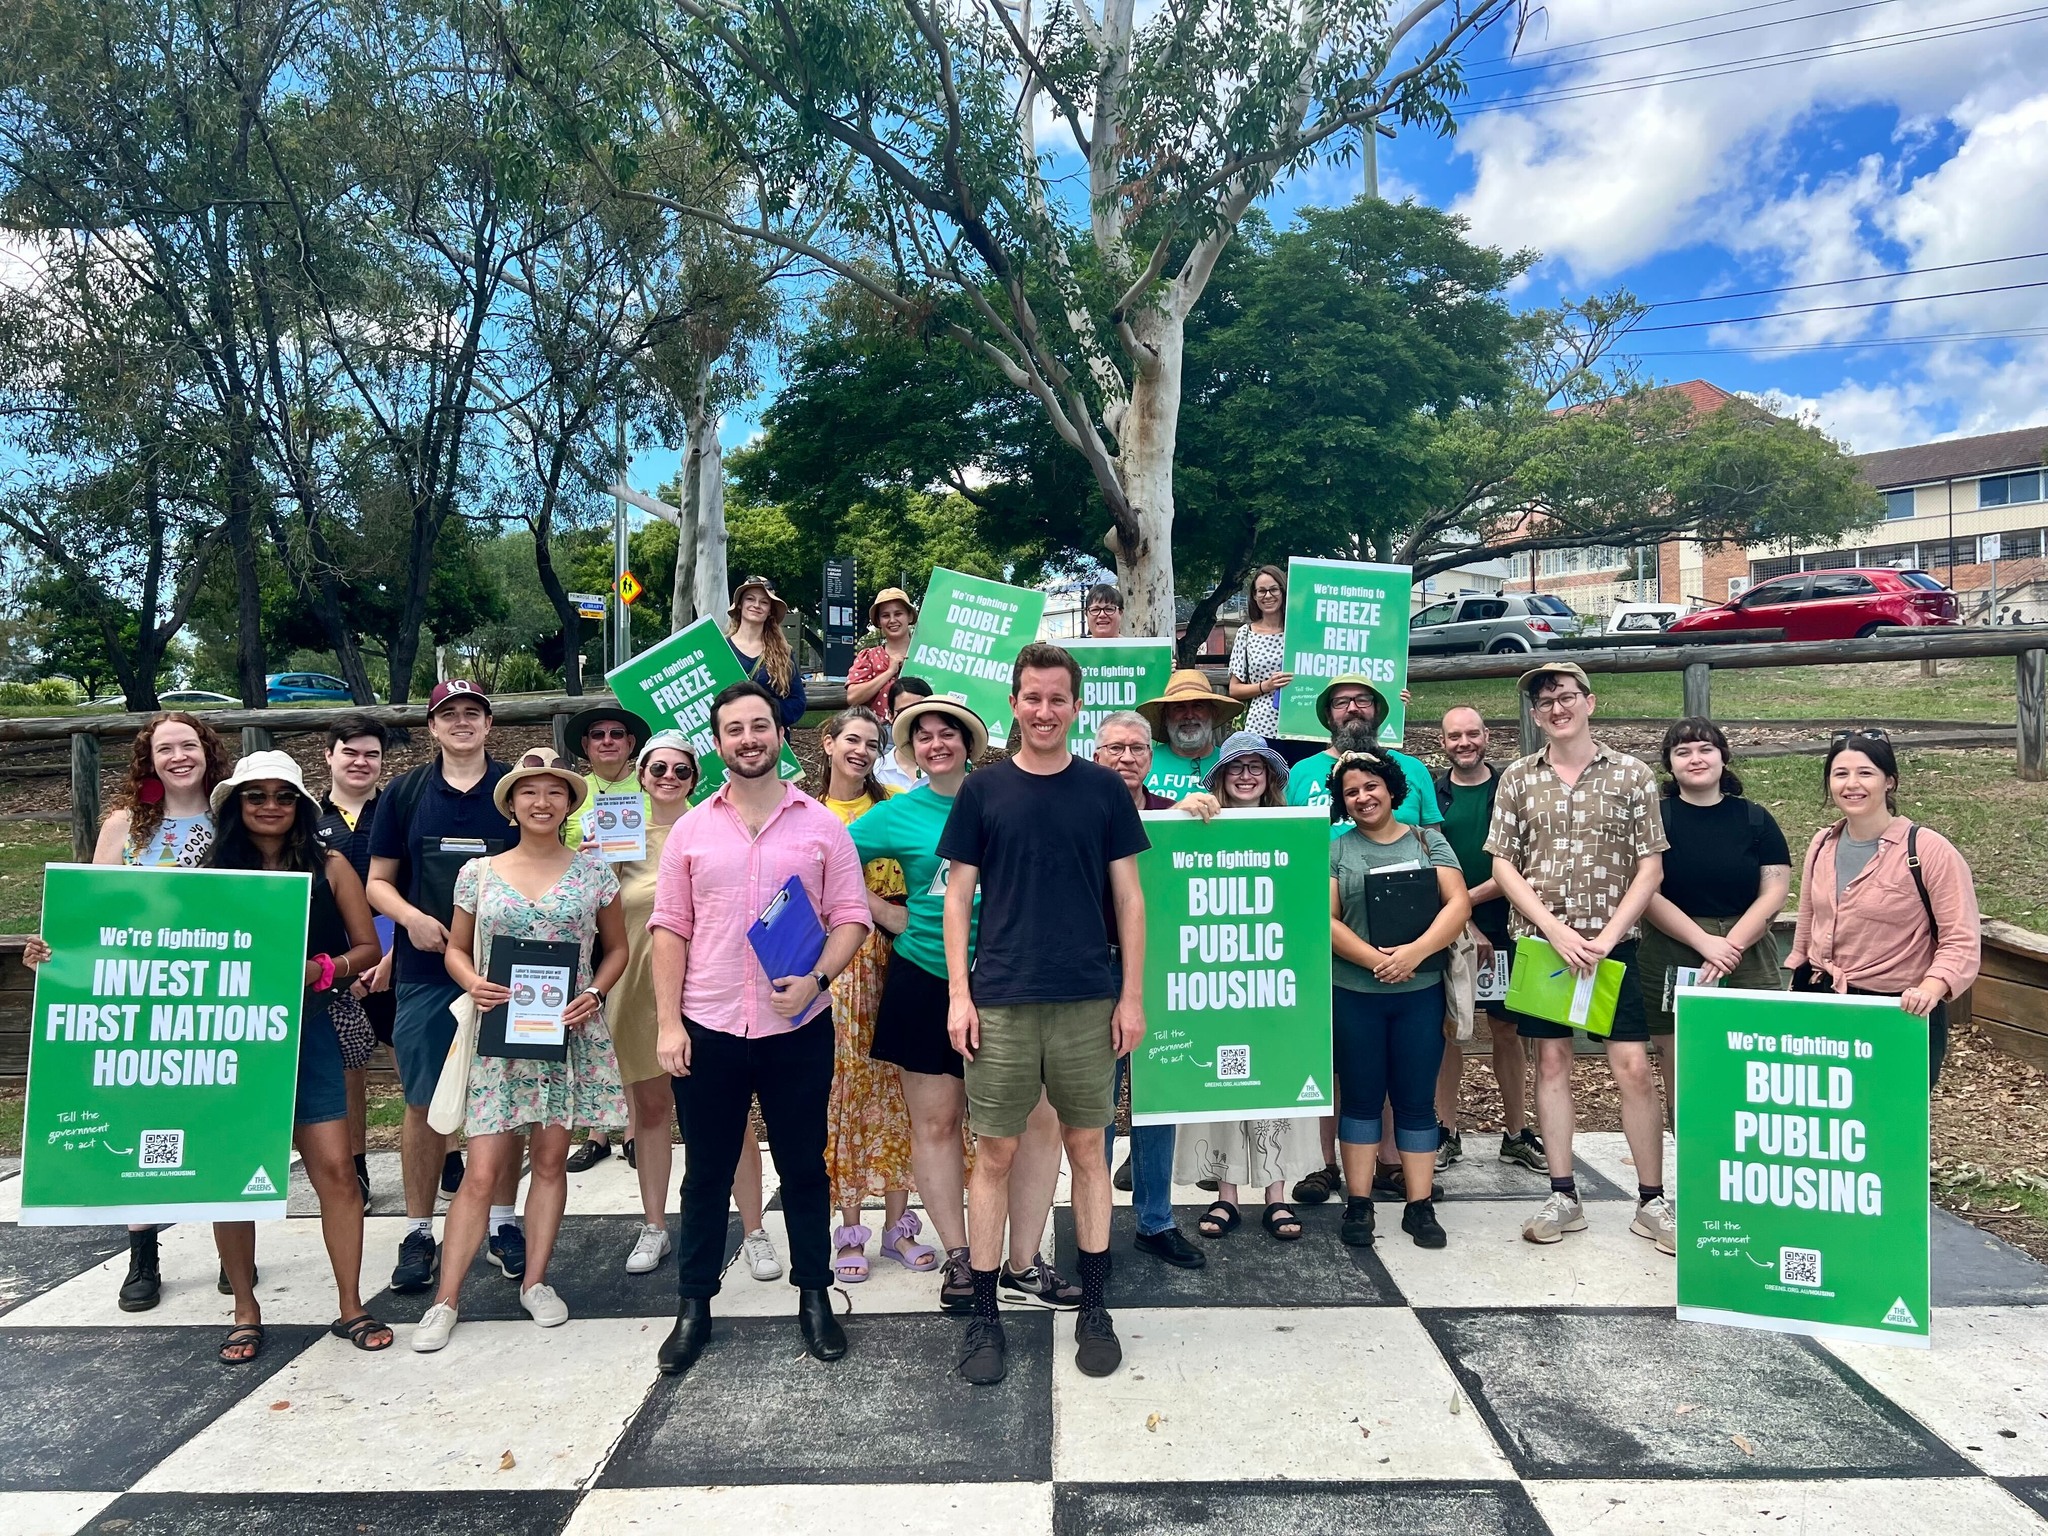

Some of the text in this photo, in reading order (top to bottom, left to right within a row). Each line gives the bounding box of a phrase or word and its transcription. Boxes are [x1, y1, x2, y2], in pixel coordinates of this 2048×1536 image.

[952, 589, 1018, 612] We're fighting to
[1314, 584, 1385, 599] We're fighting to
[946, 604, 1012, 636] DOUBLE
[1316, 599, 1380, 626] FREEZE
[950, 628, 996, 656] RENT
[1324, 627, 1370, 652] RENT
[639, 649, 704, 691] We're fighting to
[1080, 666, 1145, 677] e're fighting to
[1294, 652, 1395, 682] INCREASES
[650, 663, 717, 715] FREEZE
[1084, 682, 1136, 705] BUILD
[1148, 774, 1205, 788] A FUT
[1309, 780, 1321, 795] A
[1172, 850, 1289, 869] We're fighting to
[1188, 876, 1274, 916] BUILD
[100, 926, 252, 950] We're fighting to
[1180, 922, 1283, 963] PUBLIC
[92, 959, 251, 997] INVEST IN
[1167, 968, 1296, 1011] HOUSING
[46, 1004, 288, 1042] FIRST NATIONS
[1153, 1030, 1185, 1040] Tell the
[1149, 1039, 1193, 1059] government
[1727, 1031, 1873, 1059] We're fighting to
[93, 1049, 238, 1086] HOUSING
[1160, 1053, 1184, 1064] to act
[1746, 1060, 1853, 1109] BUILD
[57, 1111, 100, 1123] Tell the
[48, 1123, 110, 1144] government
[63, 1138, 96, 1150] to act
[1734, 1110, 1866, 1163] PUBLIC
[1719, 1159, 1882, 1217] HOUSING
[1703, 1221, 1741, 1230] Tell the
[1697, 1234, 1751, 1248] government
[1710, 1247, 1740, 1256] to act
[1888, 1314, 1911, 1323] GREENS
